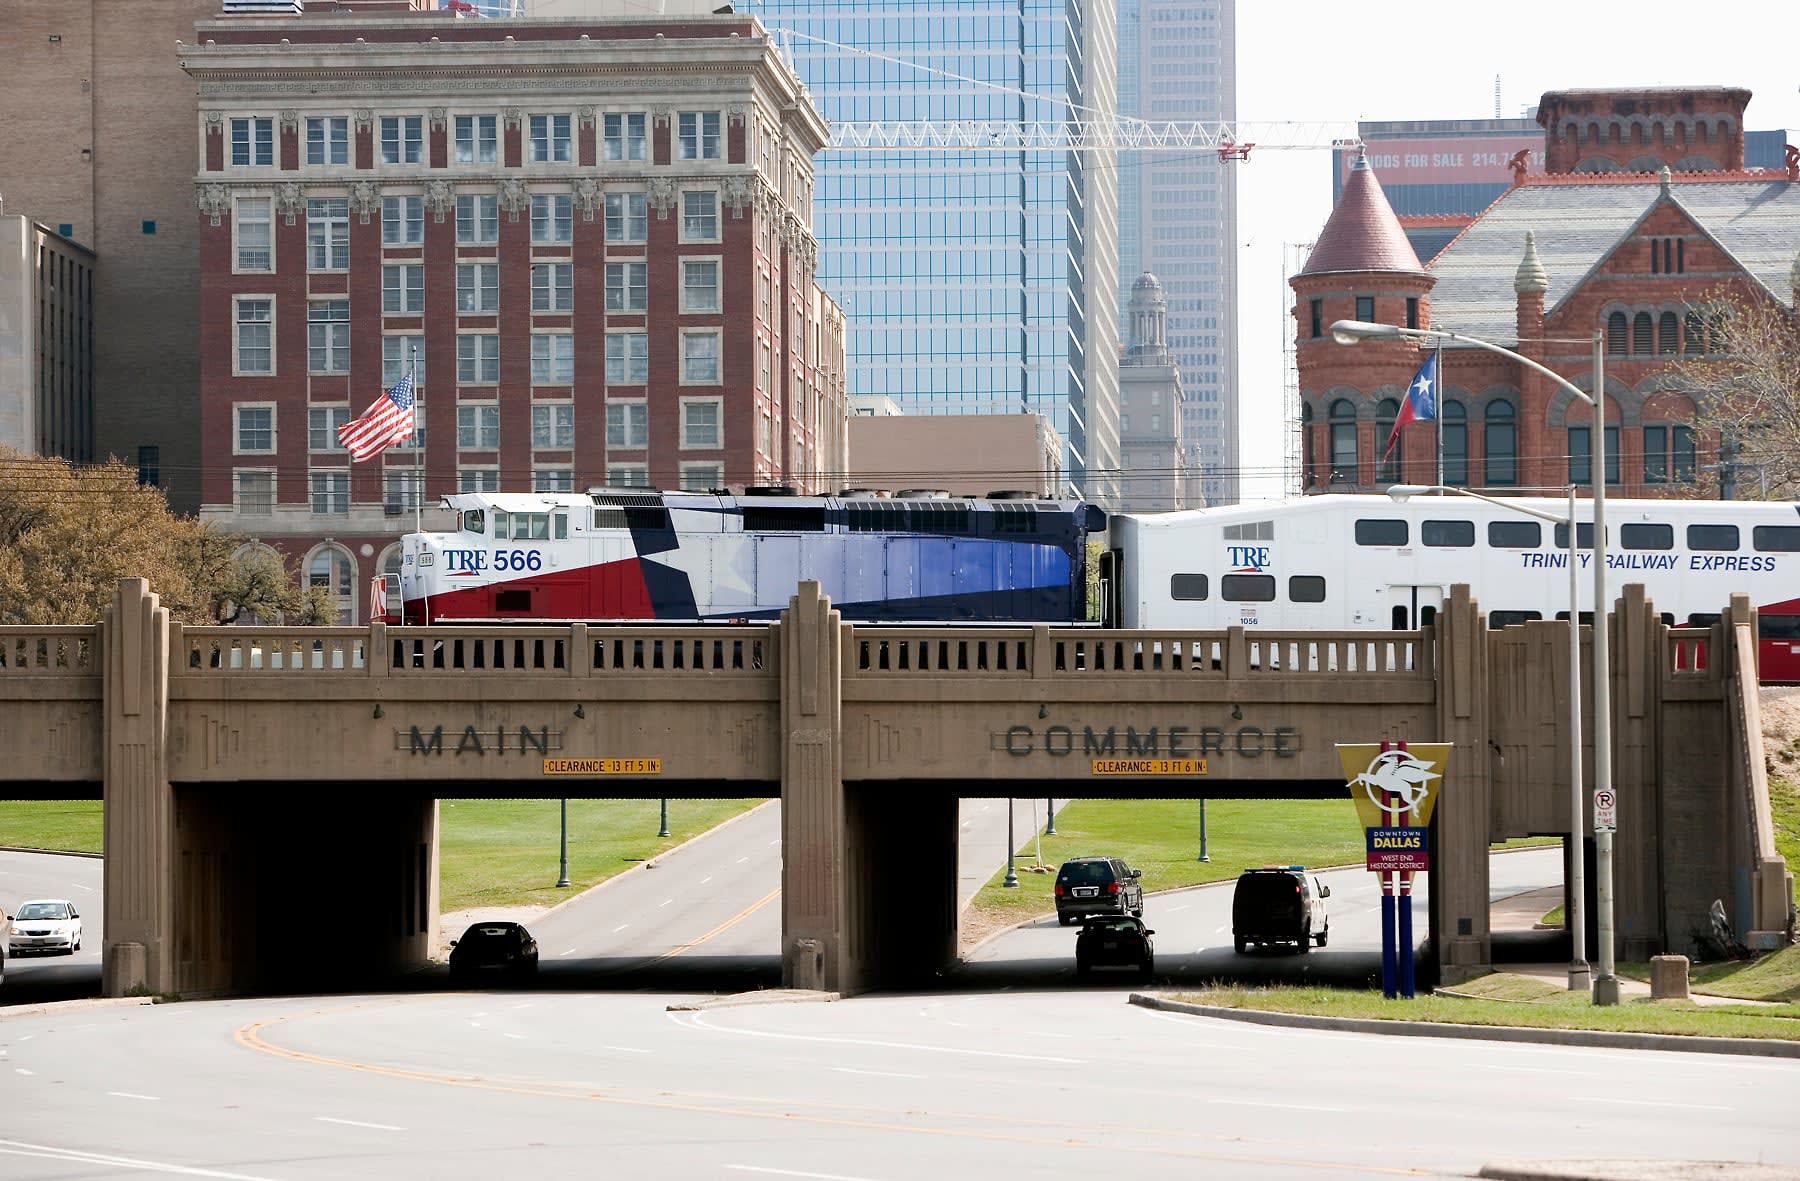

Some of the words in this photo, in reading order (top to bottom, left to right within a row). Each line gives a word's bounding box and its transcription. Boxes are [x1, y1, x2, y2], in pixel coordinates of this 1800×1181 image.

[1404, 153, 1429, 168] FOR
[1432, 152, 1464, 168] SALE
[443, 549, 488, 574] TRE
[493, 549, 542, 572] 566
[1227, 546, 1271, 571] TRE
[1521, 553, 1591, 568] TRINIY
[1689, 556, 1776, 572] EXPRESS
[410, 725, 548, 756] MAIN
[1005, 725, 1296, 758] COMMERCE
[548, 760, 605, 772] CLEARANCE
[612, 760, 621, 772] 13
[625, 760, 634, 772] FT
[638, 760, 644, 772] 5
[647, 760, 656, 772] IN
[1096, 761, 1152, 772] CLEARANCE
[1159, 761, 1169, 772] 13
[1172, 761, 1181, 772] FT
[1185, 761, 1191, 772] 6
[1194, 761, 1203, 772] IN
[1373, 837, 1421, 848] DALLAS
